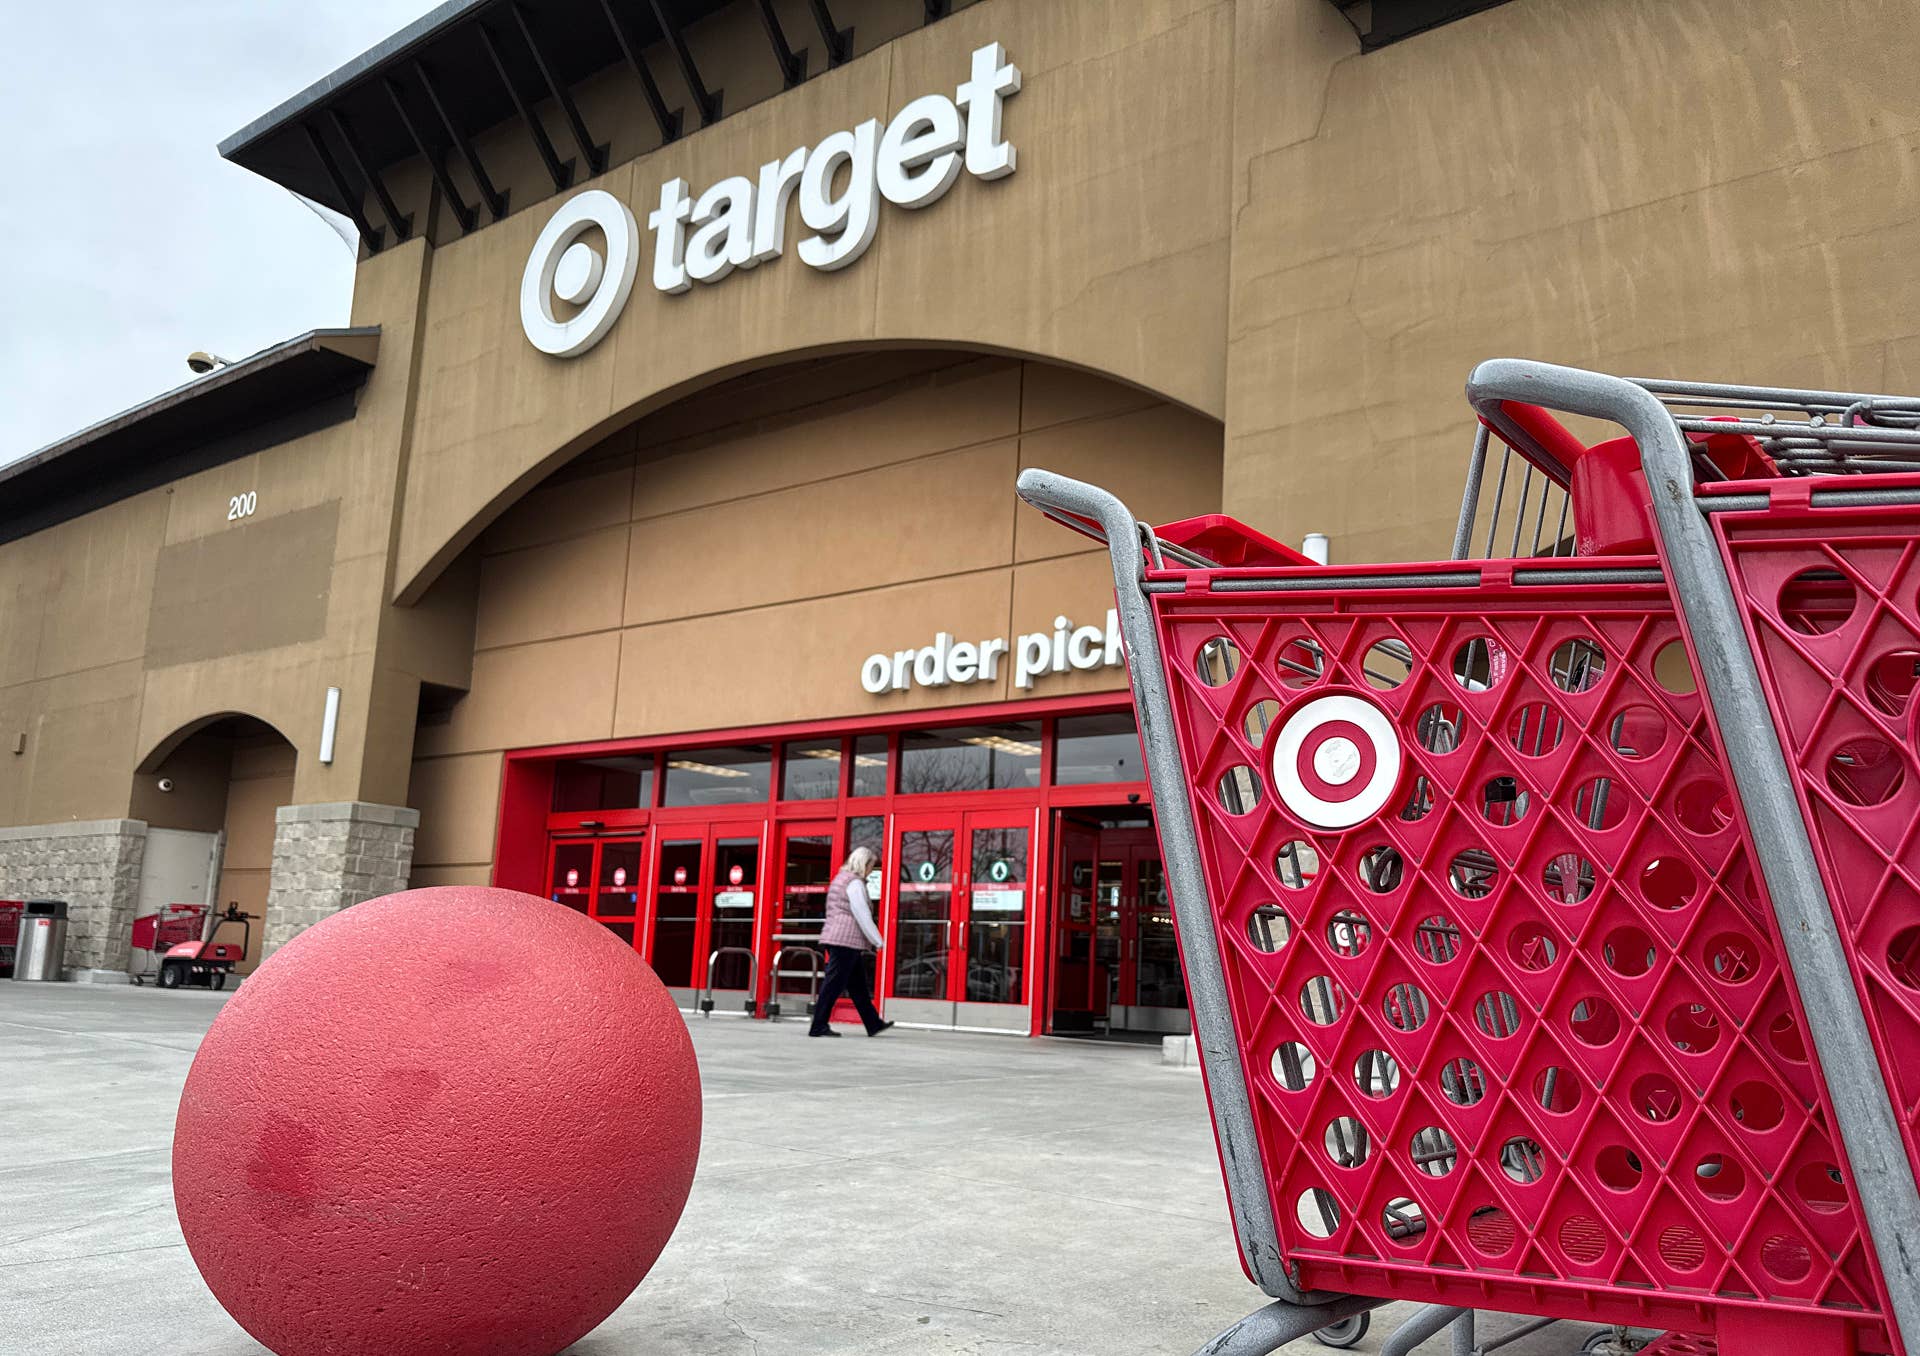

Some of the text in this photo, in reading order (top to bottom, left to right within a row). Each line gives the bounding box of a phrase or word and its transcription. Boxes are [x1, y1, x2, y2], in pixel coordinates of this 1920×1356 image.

[648, 41, 1022, 295] target
[227, 490, 257, 521] 200
[860, 631, 1009, 694] order
